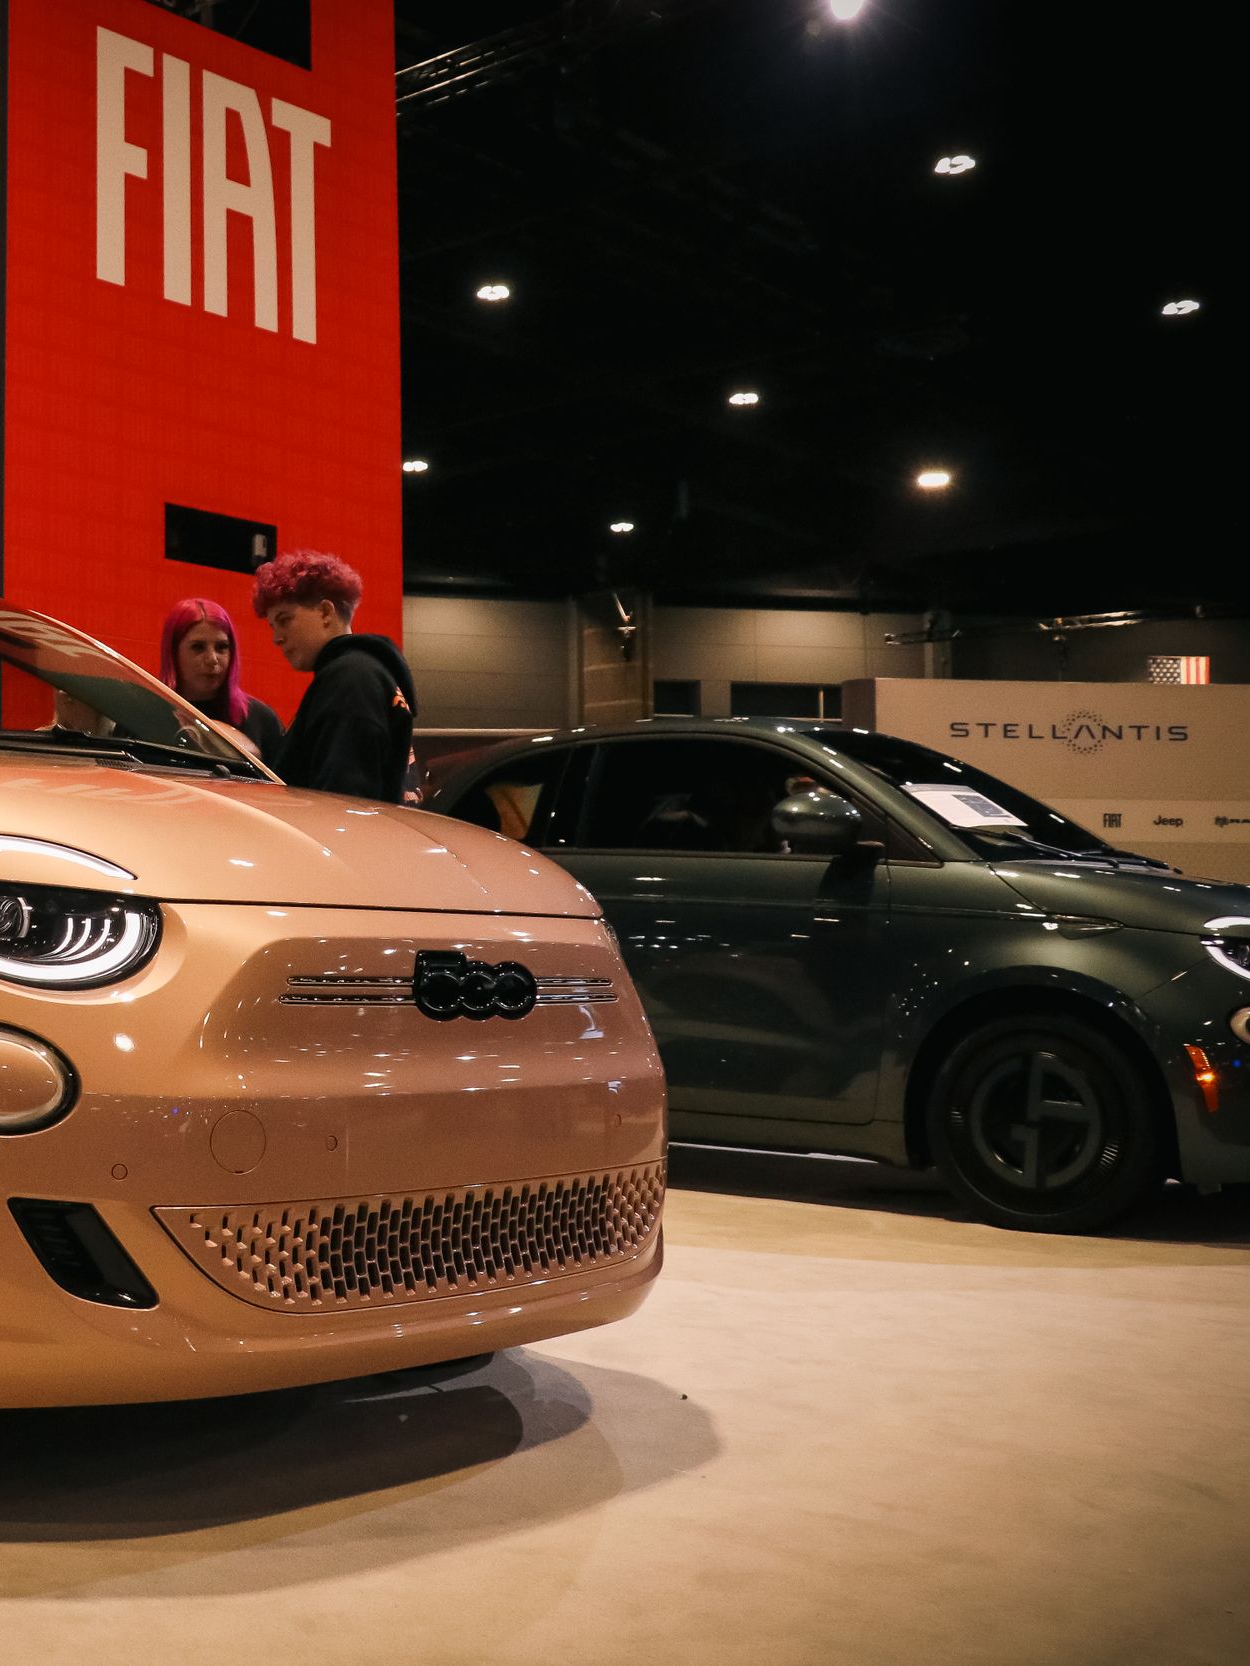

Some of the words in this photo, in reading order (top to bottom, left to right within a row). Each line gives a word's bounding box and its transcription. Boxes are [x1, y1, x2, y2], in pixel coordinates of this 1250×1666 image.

[96, 25, 331, 344] FIAT
[949, 721, 1189, 742] STELLANTIS
[1153, 815, 1183, 828] Jeep
[412, 950, 537, 1021] 500
